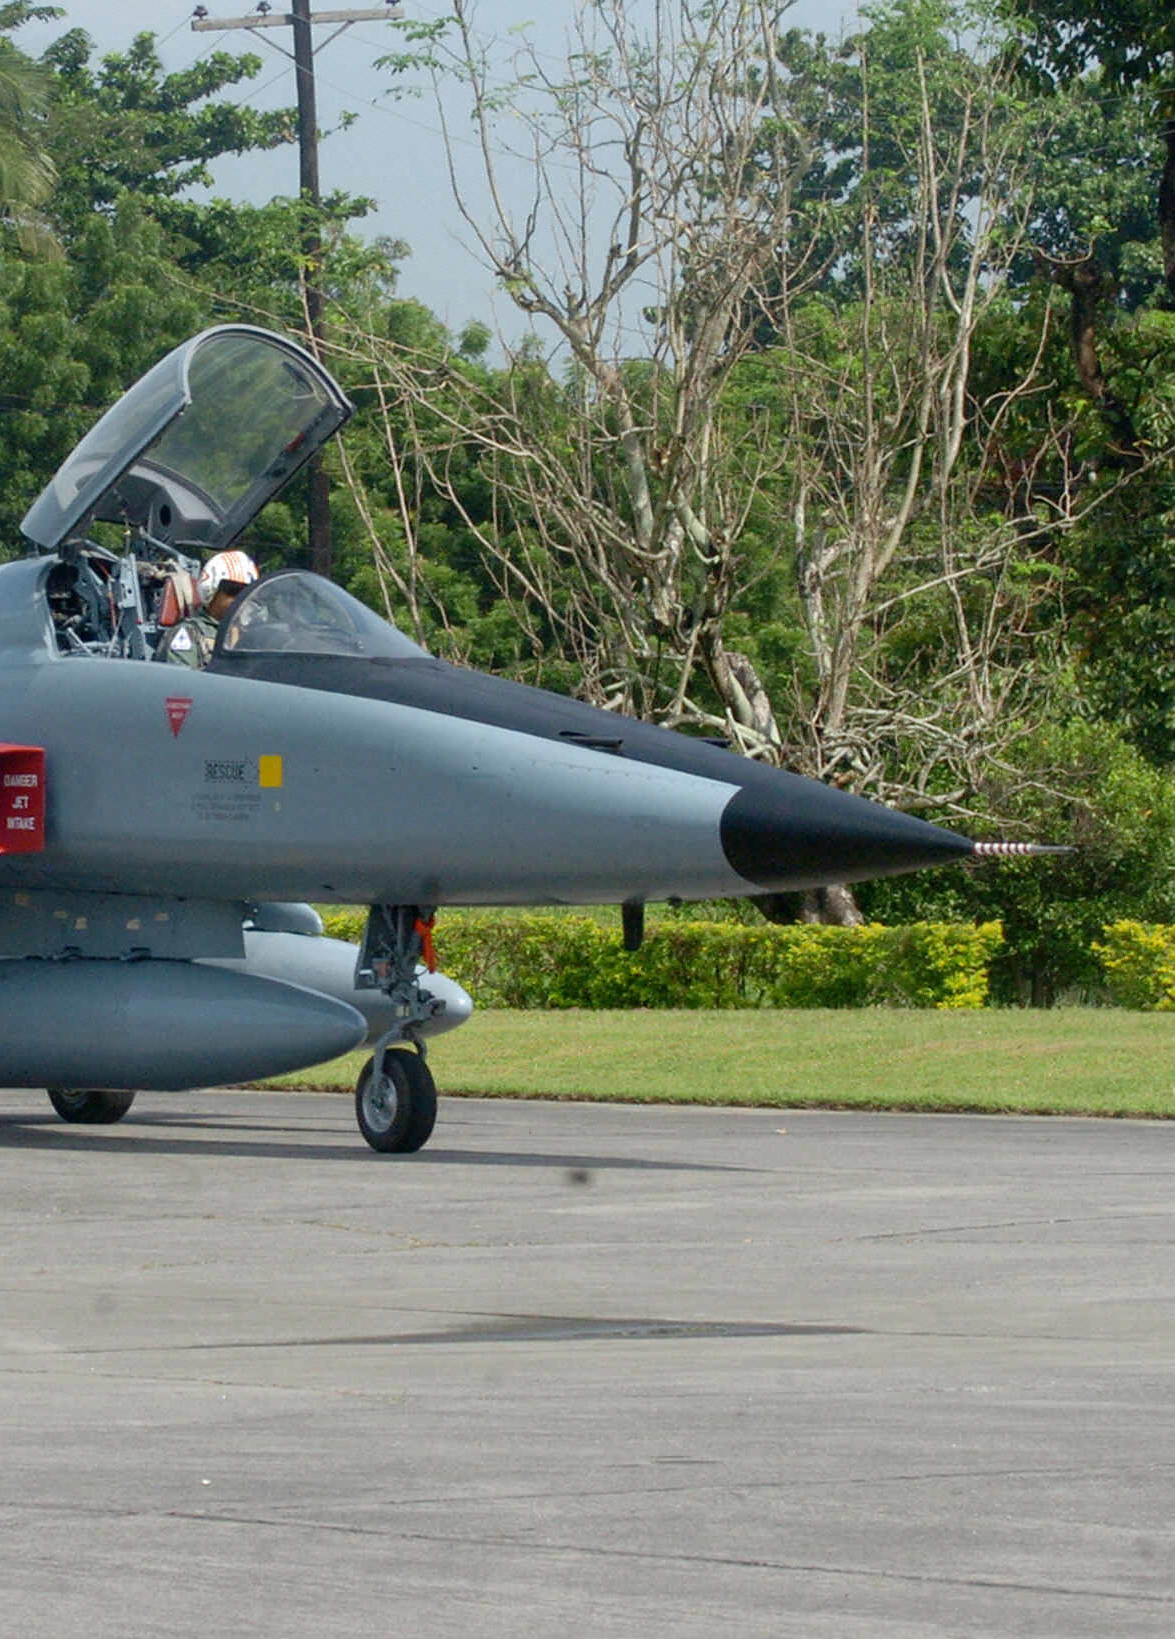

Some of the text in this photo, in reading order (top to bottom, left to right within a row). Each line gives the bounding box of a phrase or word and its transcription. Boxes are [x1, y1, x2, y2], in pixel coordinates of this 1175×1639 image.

[206, 762, 245, 781] RESCUE
[4, 774, 38, 787] DANGER
[12, 796, 29, 809] JET
[6, 817, 35, 830] INTAKE
